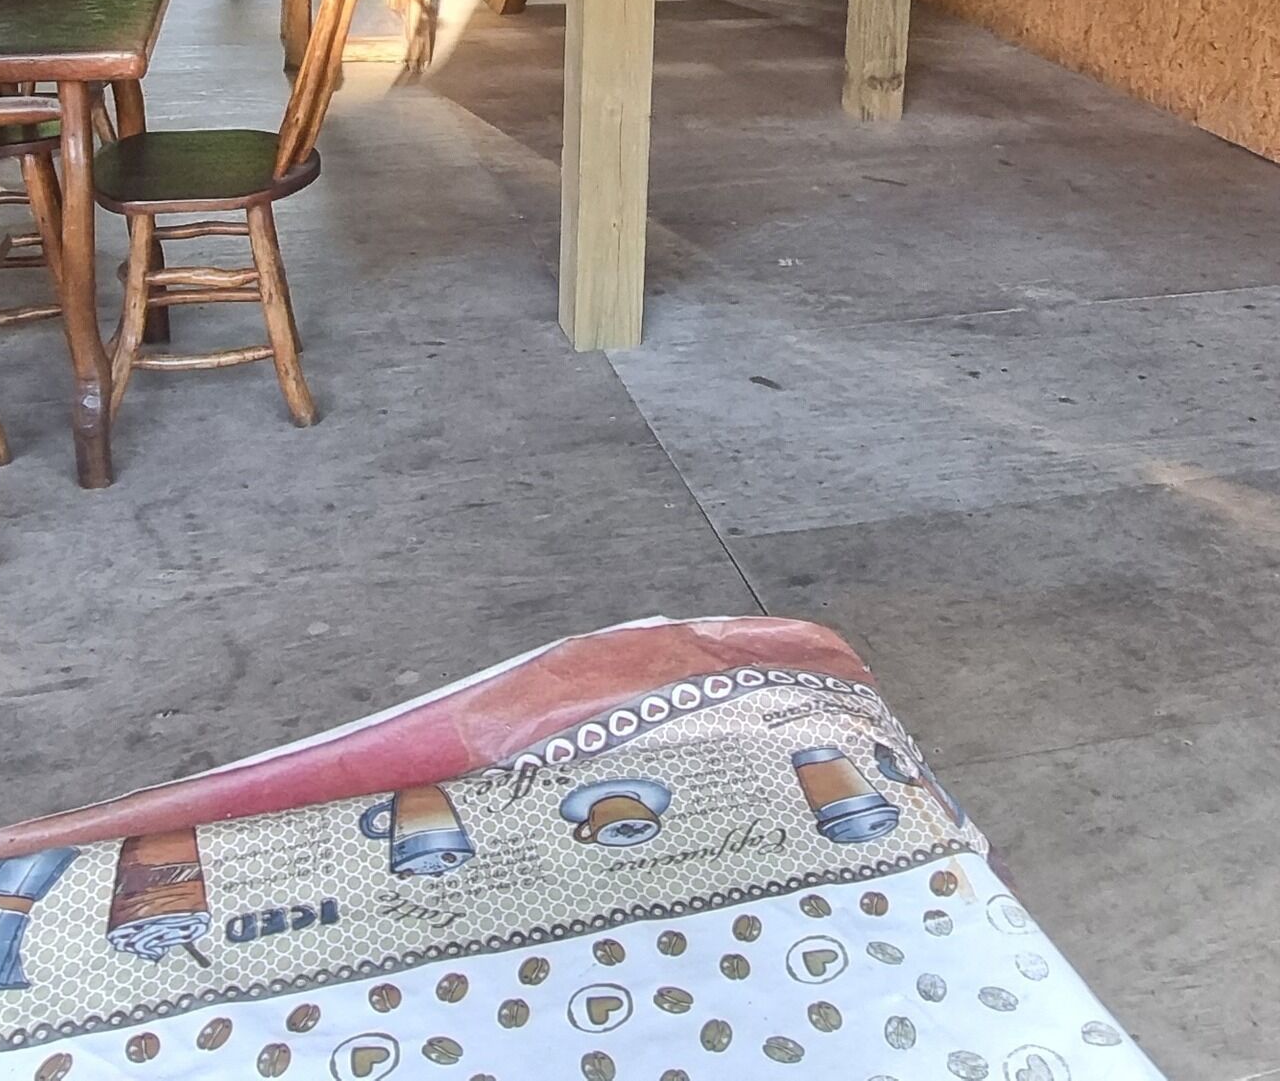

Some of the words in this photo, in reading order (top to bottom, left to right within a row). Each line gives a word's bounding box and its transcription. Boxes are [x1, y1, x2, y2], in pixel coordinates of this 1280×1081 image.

[599, 818, 786, 876] Cappuccino
[225, 897, 339, 943] ICED
[375, 890, 468, 929] Latte
